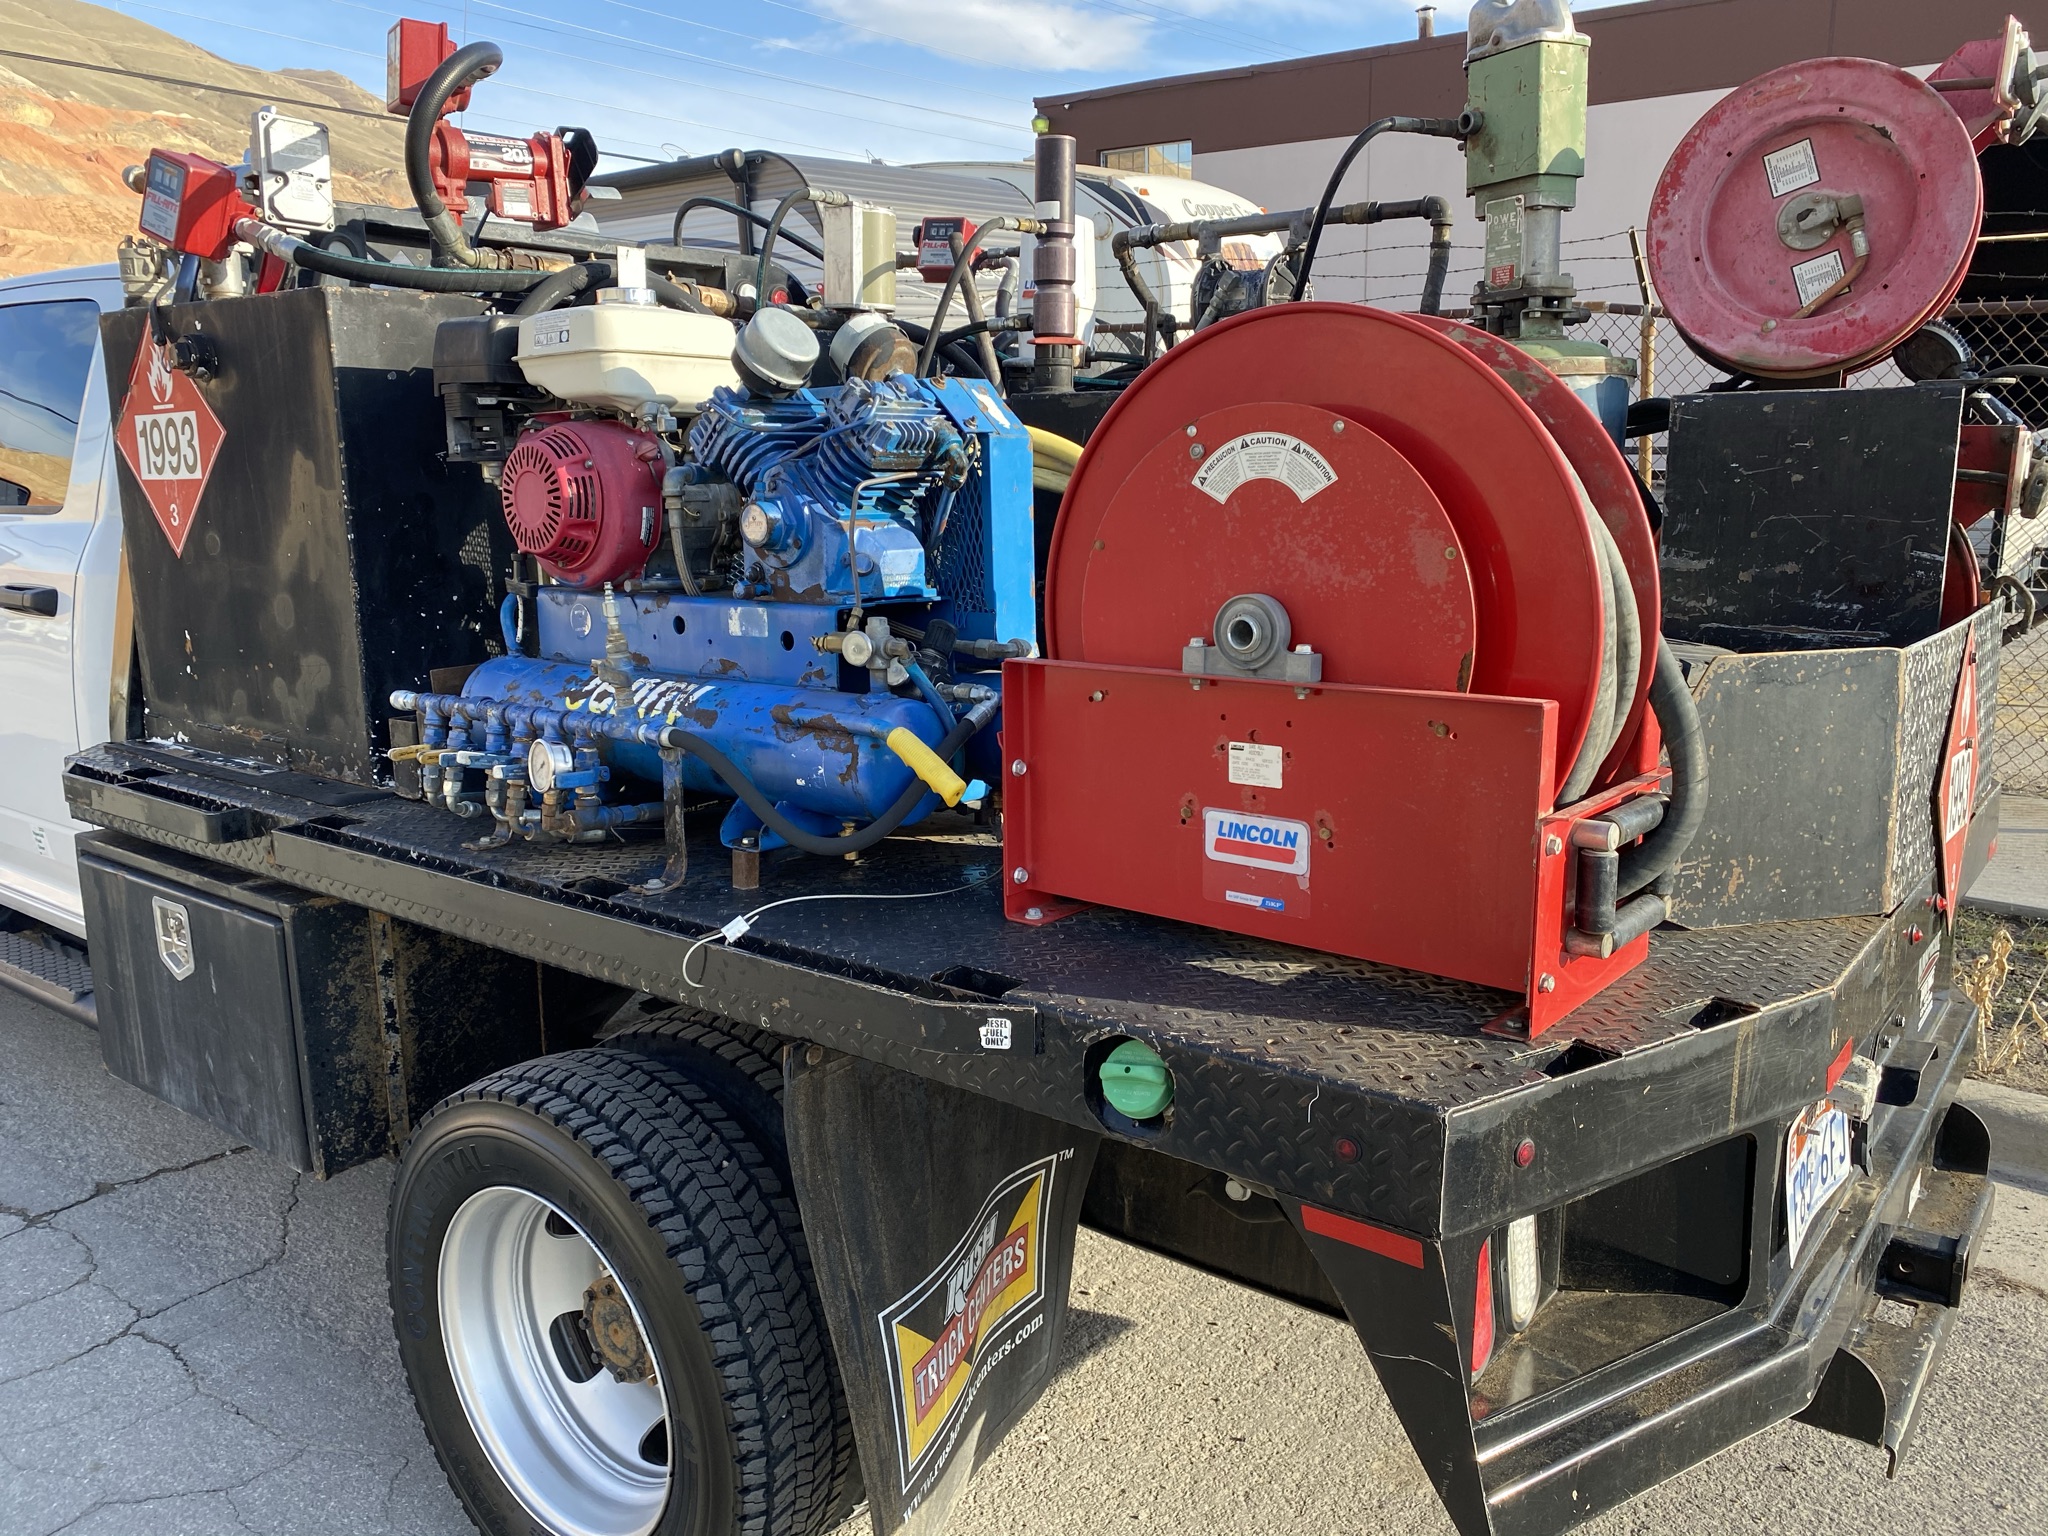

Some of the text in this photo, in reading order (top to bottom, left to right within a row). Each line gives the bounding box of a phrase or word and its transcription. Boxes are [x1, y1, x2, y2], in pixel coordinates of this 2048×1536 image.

[1182, 198, 1234, 219] Copper
[1487, 206, 1522, 239] POWER
[139, 416, 198, 475] 1993
[1250, 436, 1288, 446] CAUTION
[1204, 446, 1236, 475] PRECAUCION
[169, 503, 180, 527] 3
[1217, 820, 1299, 849] LINCOLN
[1265, 900, 1283, 908] SKF
[984, 1029, 1004, 1037] FUEL
[985, 1037, 1004, 1047] ONLY
[1059, 1148, 1075, 1161] TM
[943, 1211, 999, 1325] RUSH
[916, 1236, 1026, 1408] TRUCK CENTERS
